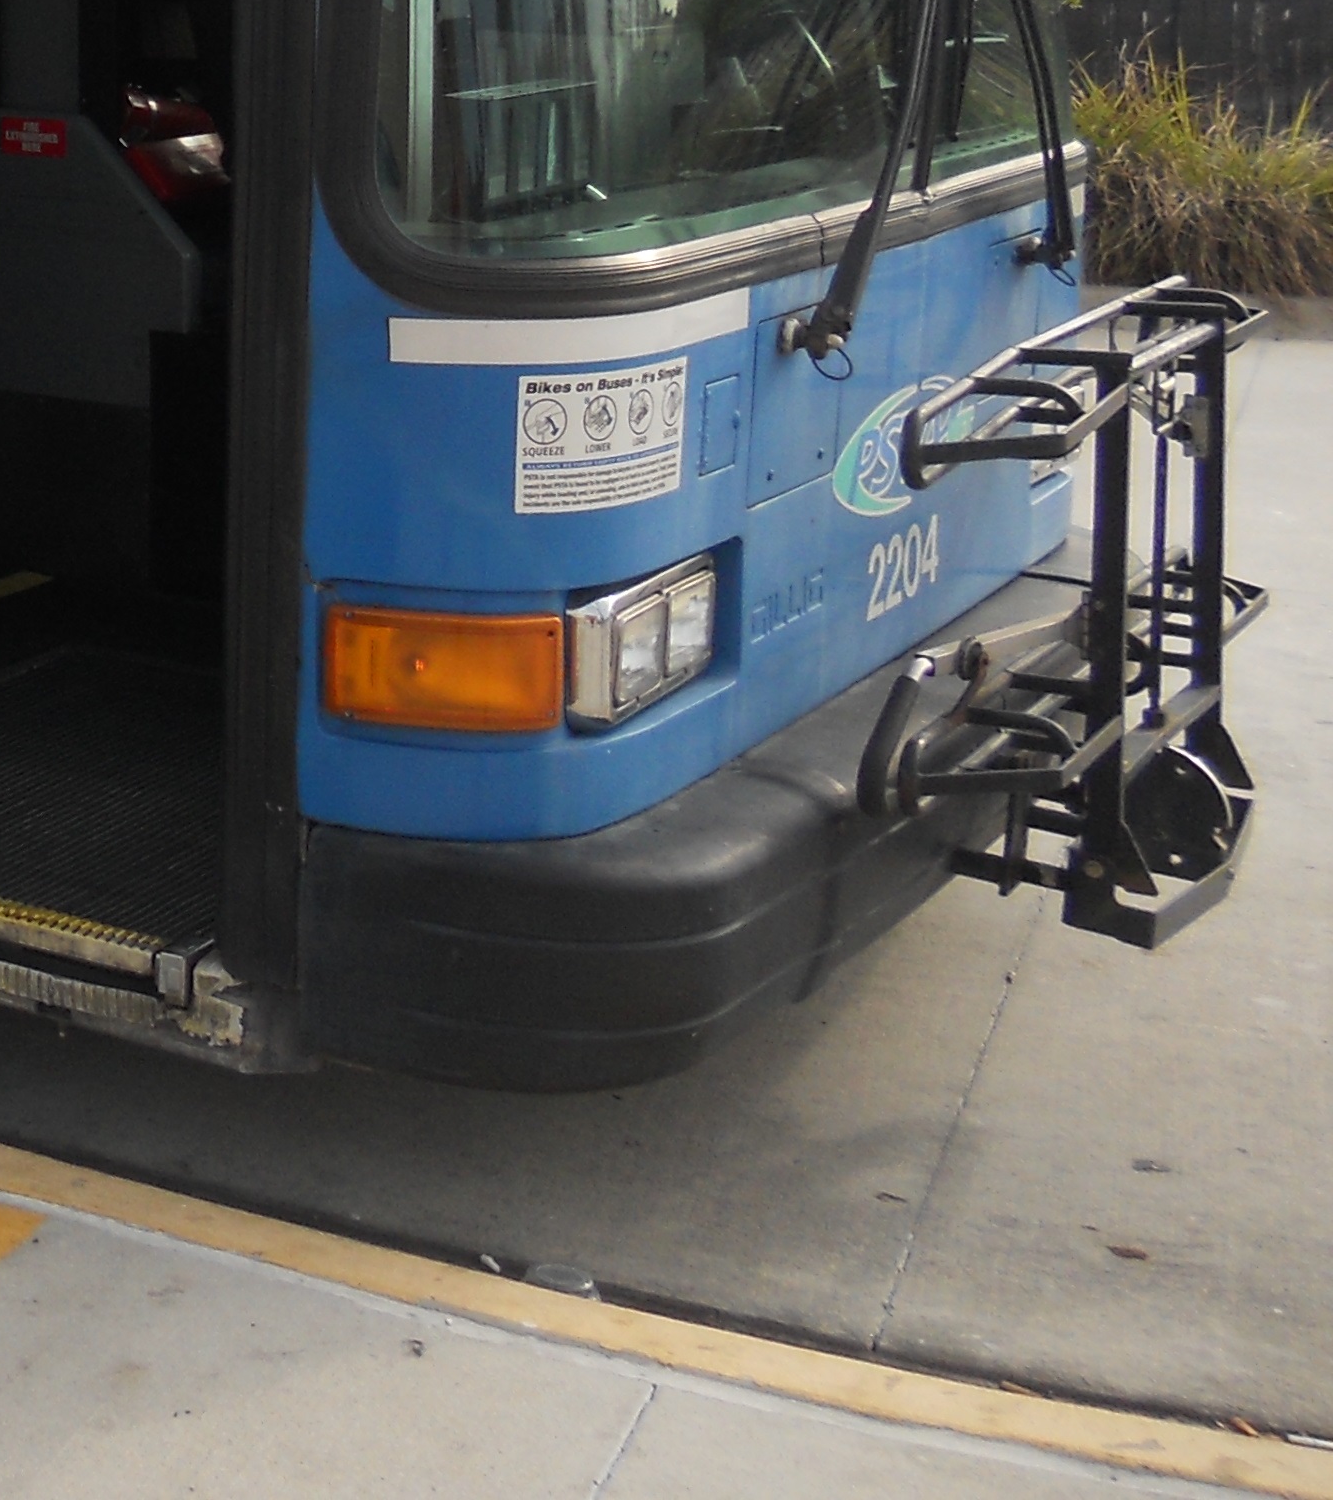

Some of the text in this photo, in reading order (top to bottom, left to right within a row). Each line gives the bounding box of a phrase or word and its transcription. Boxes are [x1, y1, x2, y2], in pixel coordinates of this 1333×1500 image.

[525, 381, 572, 394] Bikes
[575, 381, 593, 393] on
[597, 377, 633, 391] Buses
[521, 445, 565, 458] SQUEEZE
[866, 513, 939, 622] 2204
